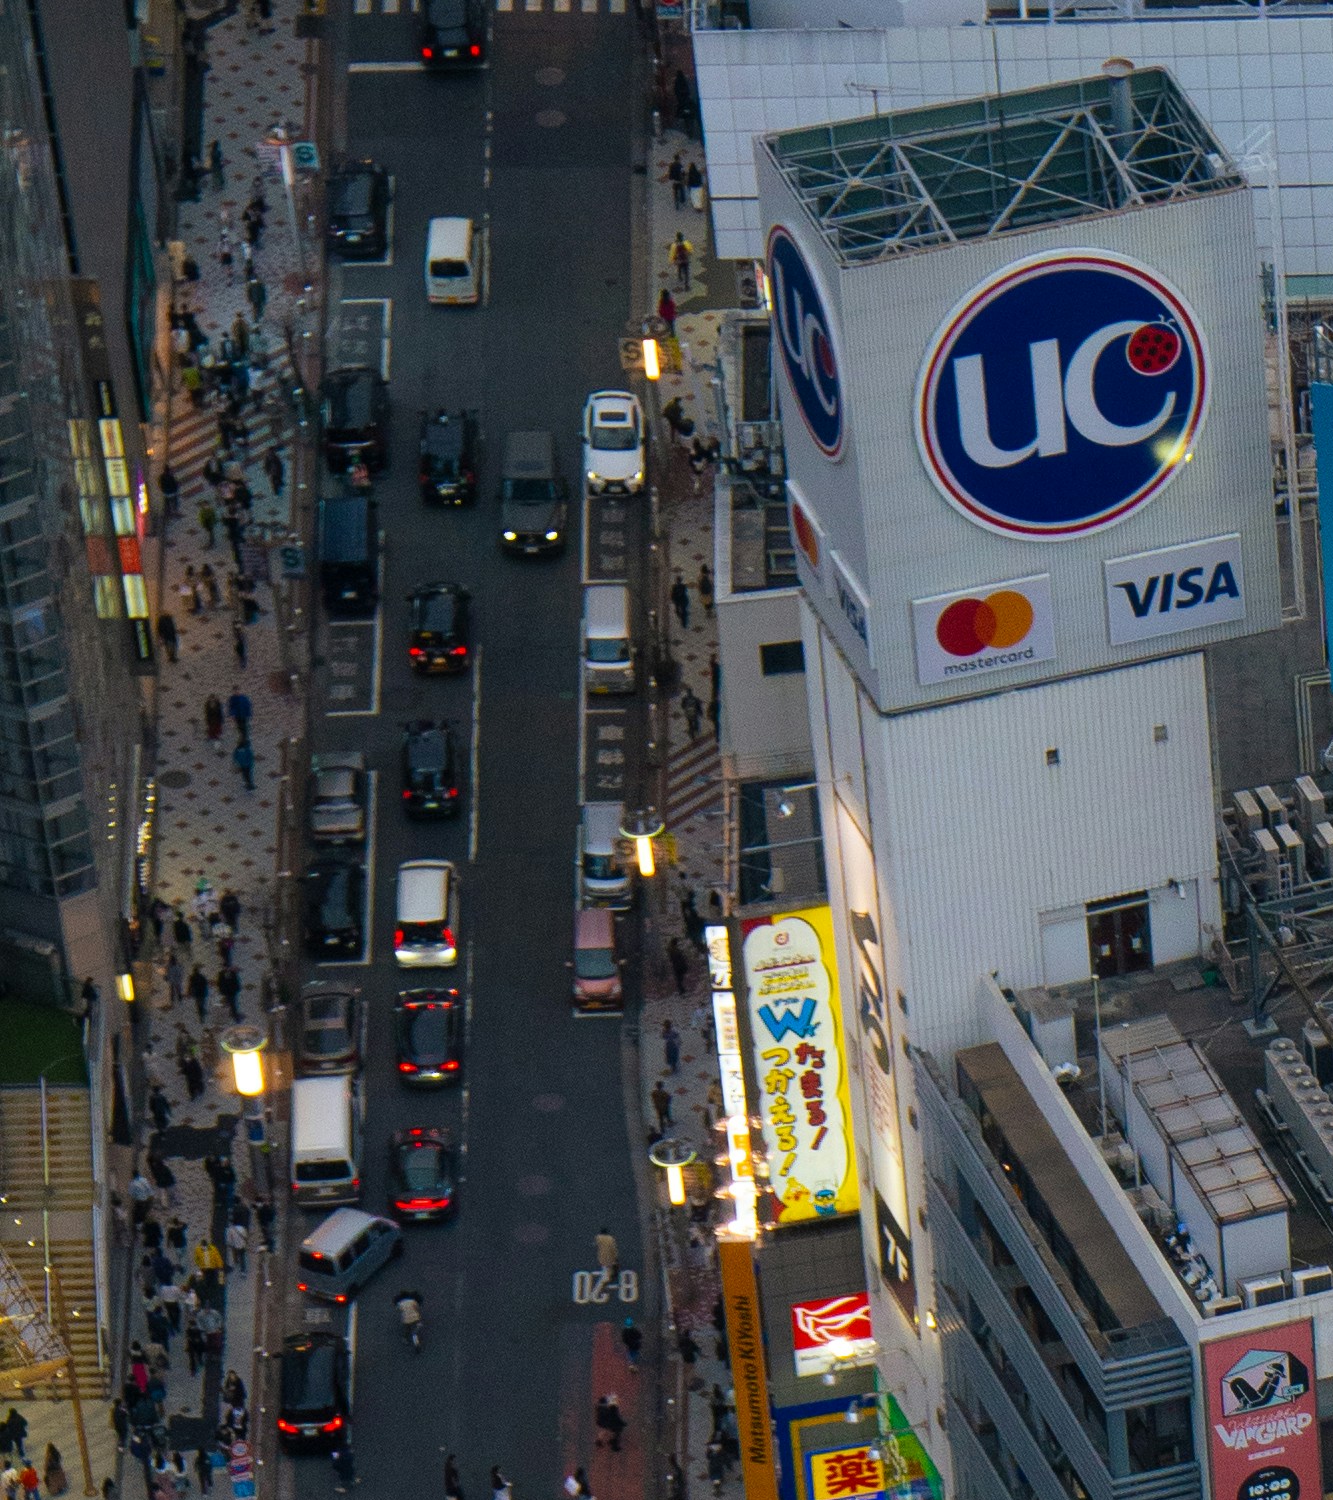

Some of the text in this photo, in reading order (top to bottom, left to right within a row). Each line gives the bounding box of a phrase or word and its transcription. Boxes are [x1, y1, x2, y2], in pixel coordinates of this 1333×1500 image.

[953, 315, 1181, 469] UC
[1113, 560, 1240, 618] VISA
[943, 645, 1035, 677] mastercard
[746, 1360, 771, 1466] Matsumoto
[1214, 1411, 1313, 1451] VANGUARD
[823, 1451, 882, 1497] 薬
